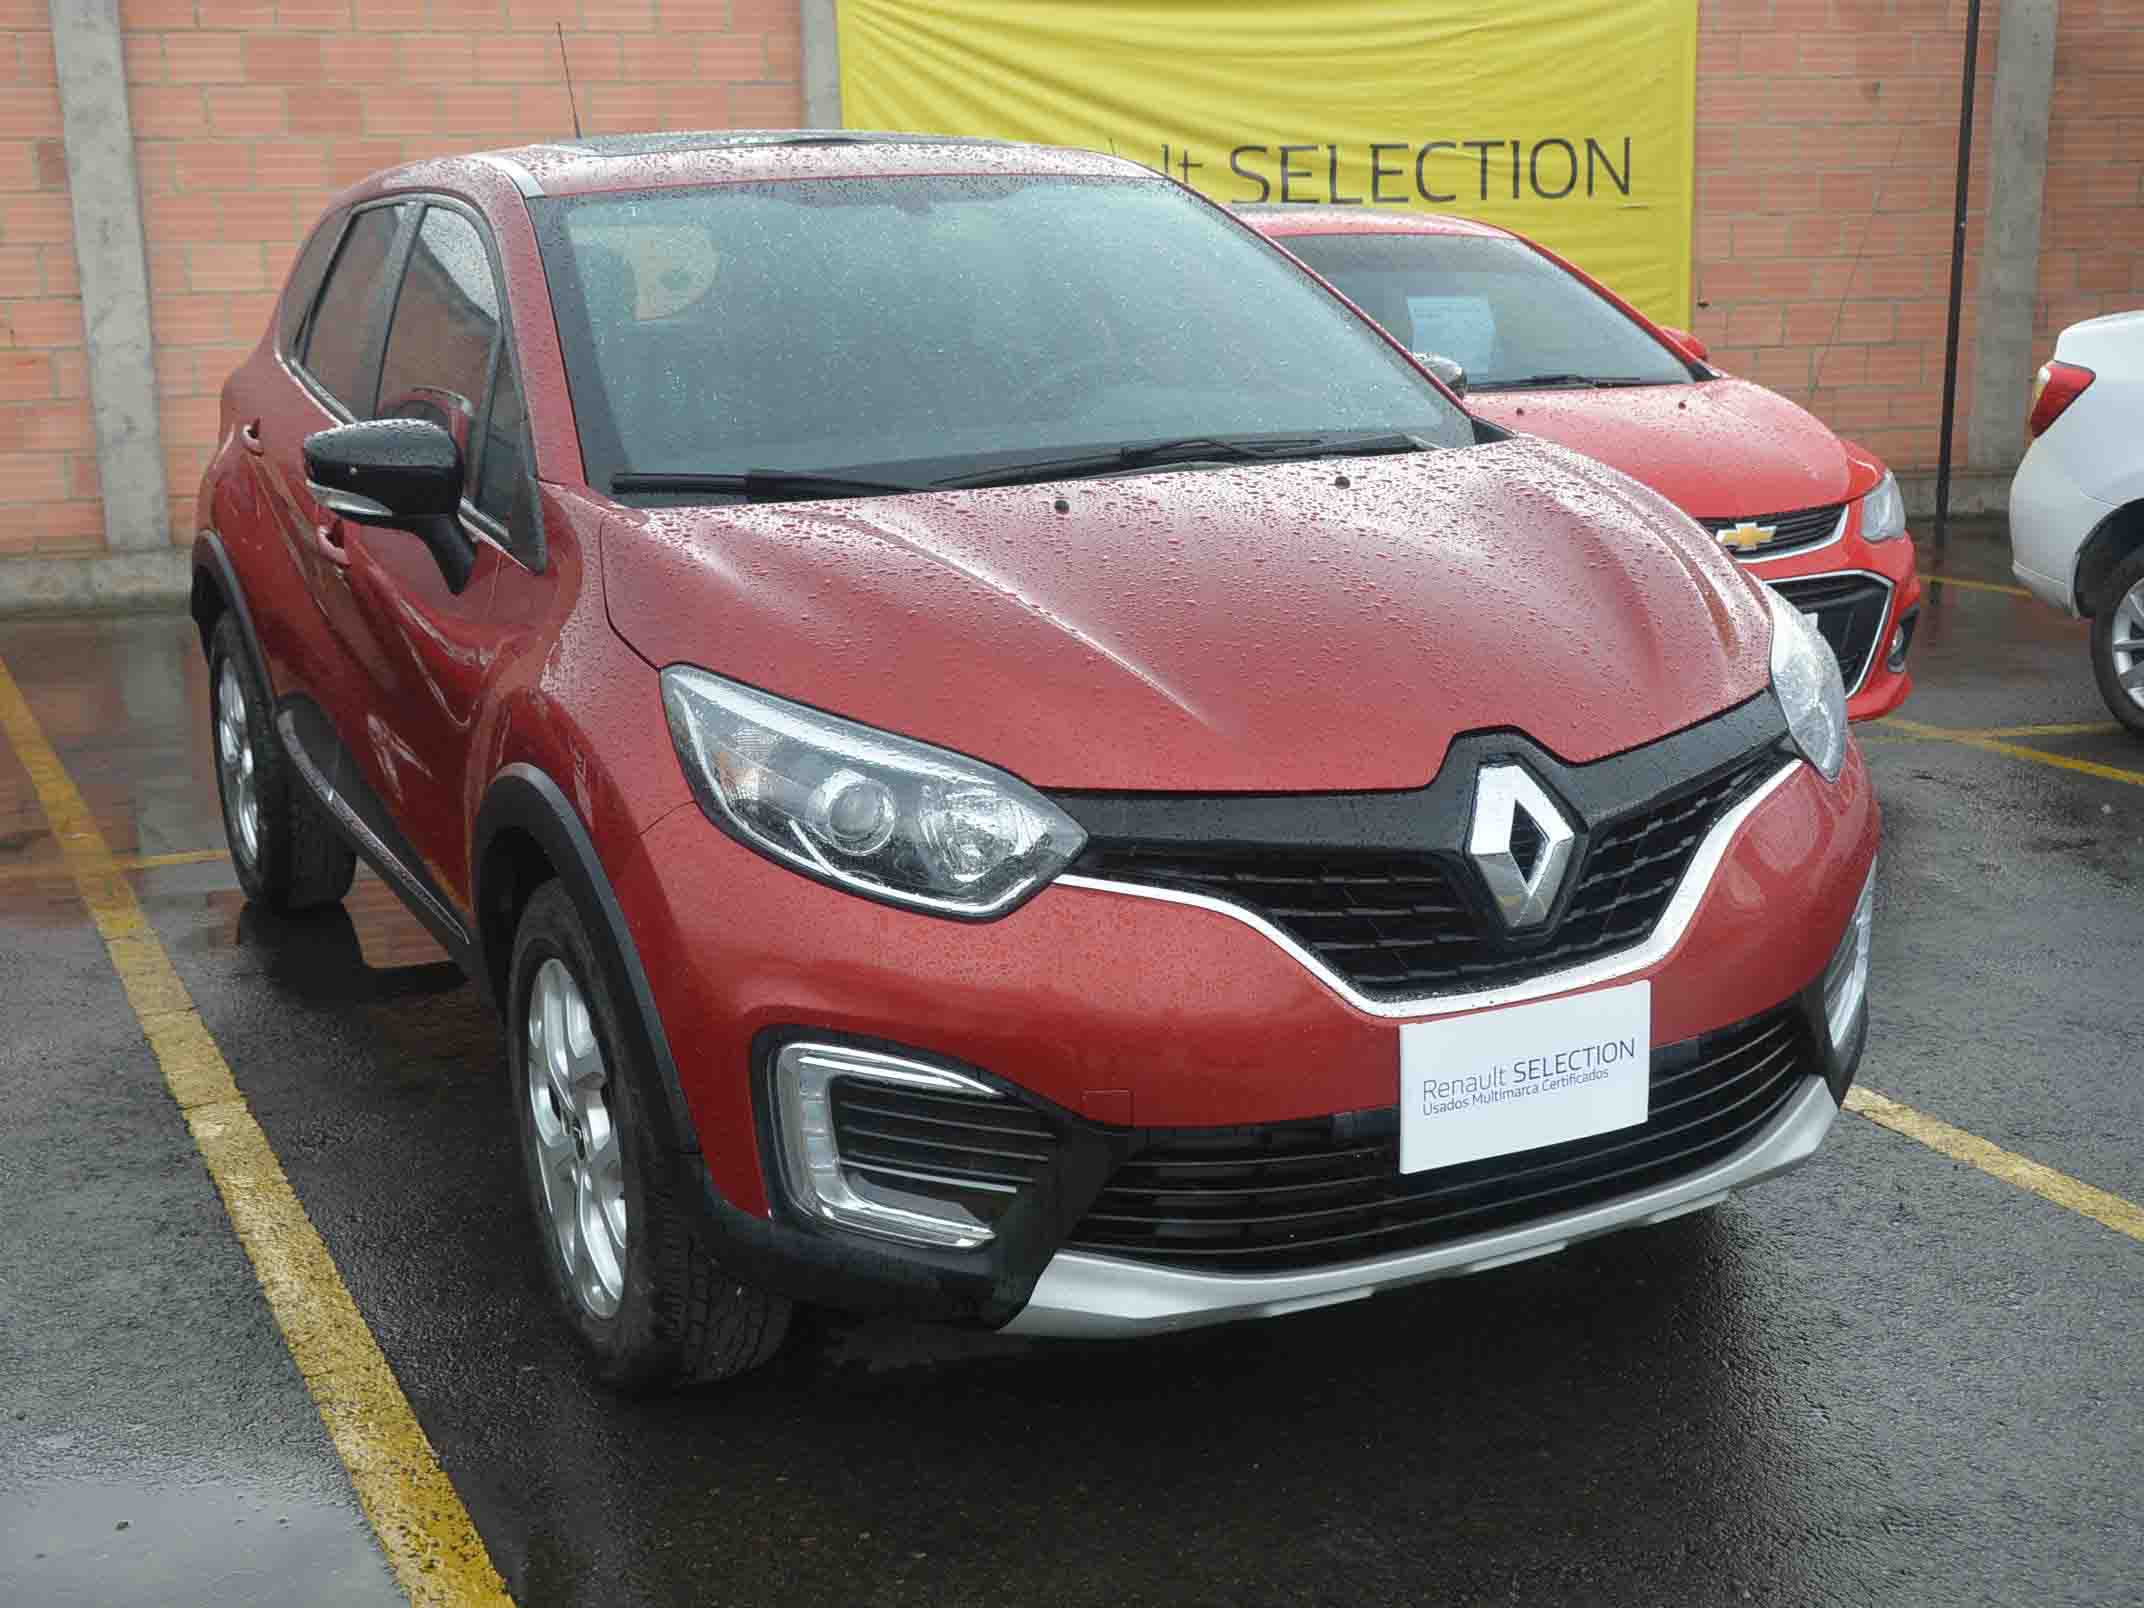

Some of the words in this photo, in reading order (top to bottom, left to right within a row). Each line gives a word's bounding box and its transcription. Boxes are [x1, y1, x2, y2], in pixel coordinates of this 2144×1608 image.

[1229, 136, 1631, 205] SELECTION
[1423, 1065, 1507, 1102] Renault
[1512, 1037, 1635, 1083] SELECTION
[1423, 1097, 1469, 1116] Usados
[1472, 1083, 1539, 1105] Multimarca
[1541, 1067, 1609, 1092] Certificados
